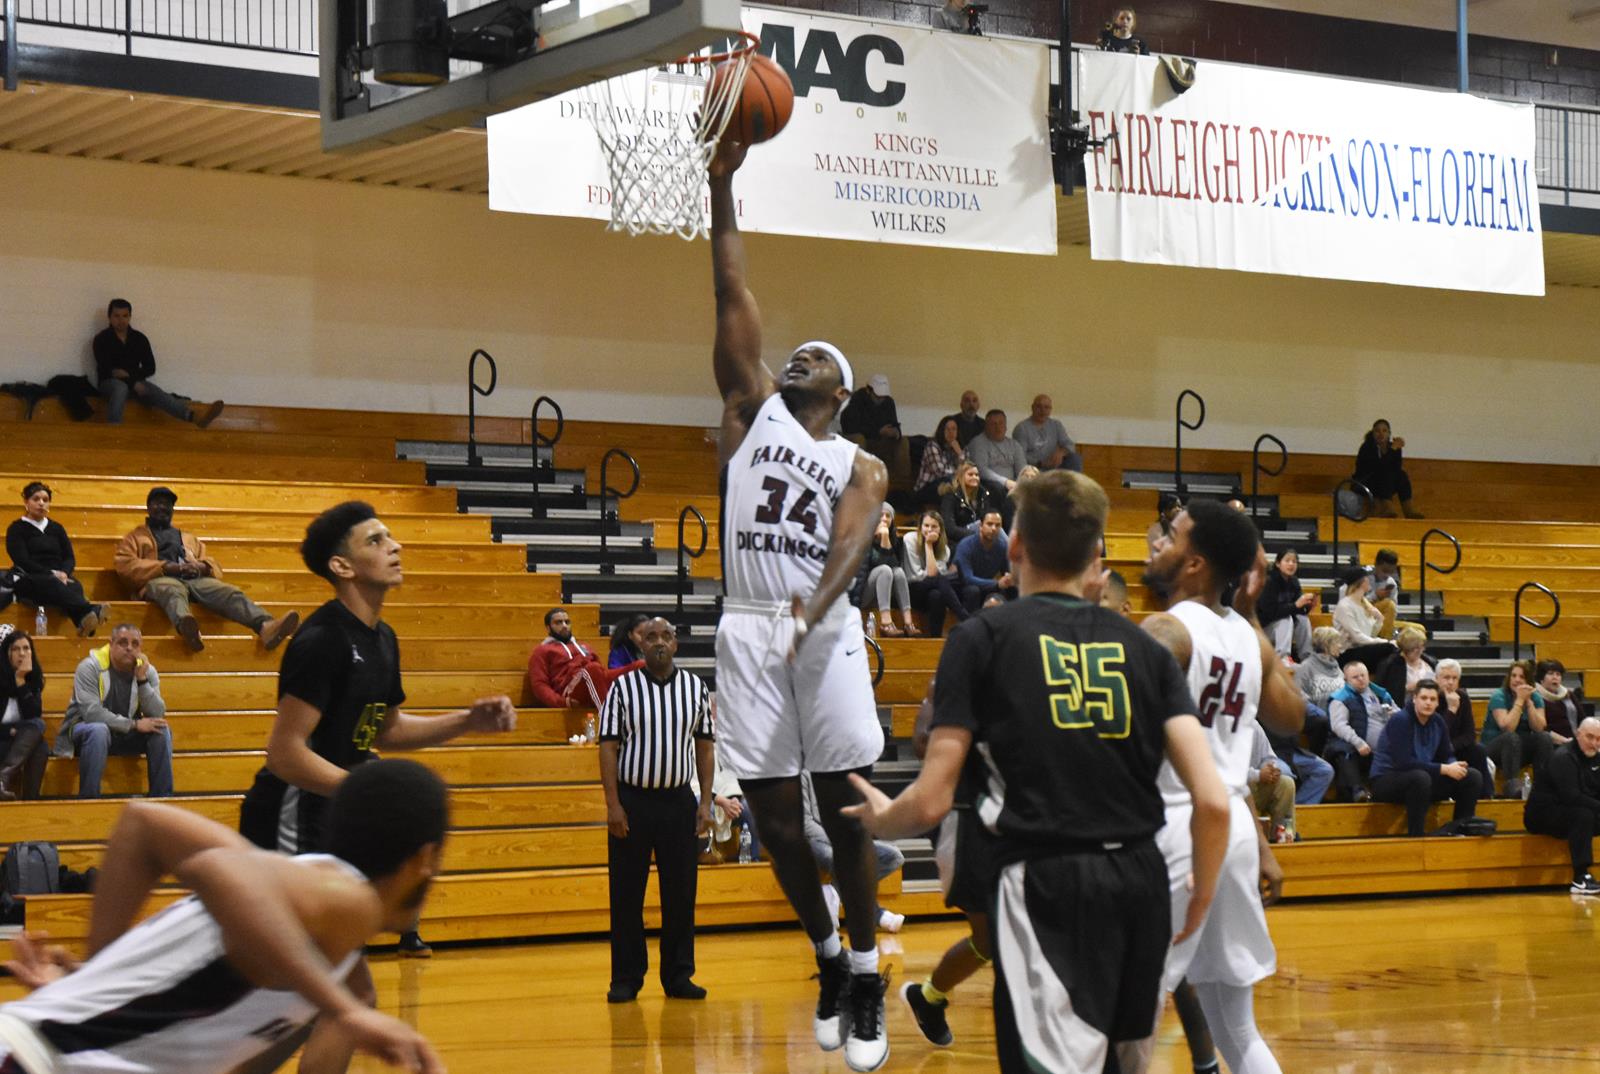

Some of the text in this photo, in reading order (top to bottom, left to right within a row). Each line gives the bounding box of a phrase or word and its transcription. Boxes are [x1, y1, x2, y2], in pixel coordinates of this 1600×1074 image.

[874, 133, 938, 156] KING'S
[1088, 110, 1244, 204] FAIRLEIGH
[814, 153, 999, 187] MANHATTANVILLE
[834, 181, 982, 211] MISERICORDIA
[871, 210, 947, 234] WILKES
[755, 475, 818, 535] 34
[1039, 635, 1131, 738] 55
[1200, 656, 1245, 733] 24
